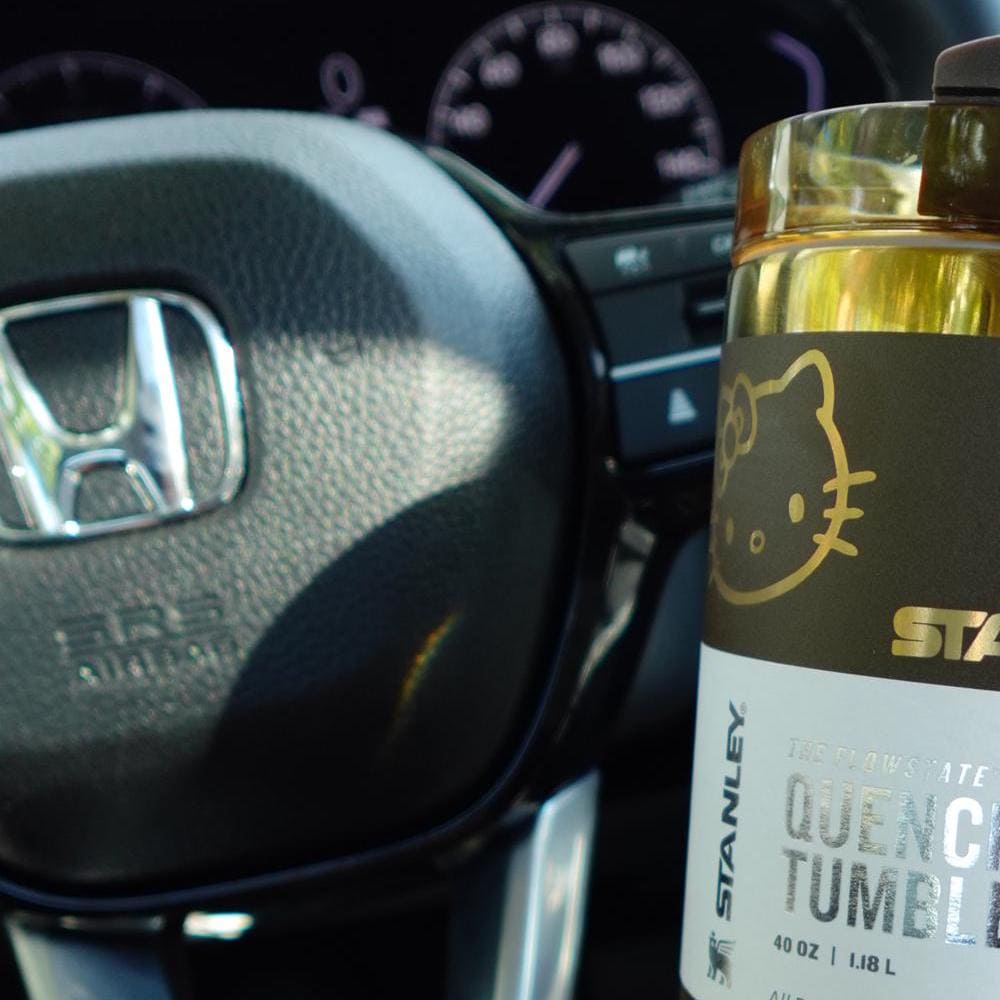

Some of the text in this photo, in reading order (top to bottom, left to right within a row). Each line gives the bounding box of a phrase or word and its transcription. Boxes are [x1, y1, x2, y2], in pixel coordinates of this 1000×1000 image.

[773, 934, 793, 953] 40
[796, 940, 820, 960] OZ
[849, 952, 880, 973] 1.18
[885, 958, 896, 976] L
